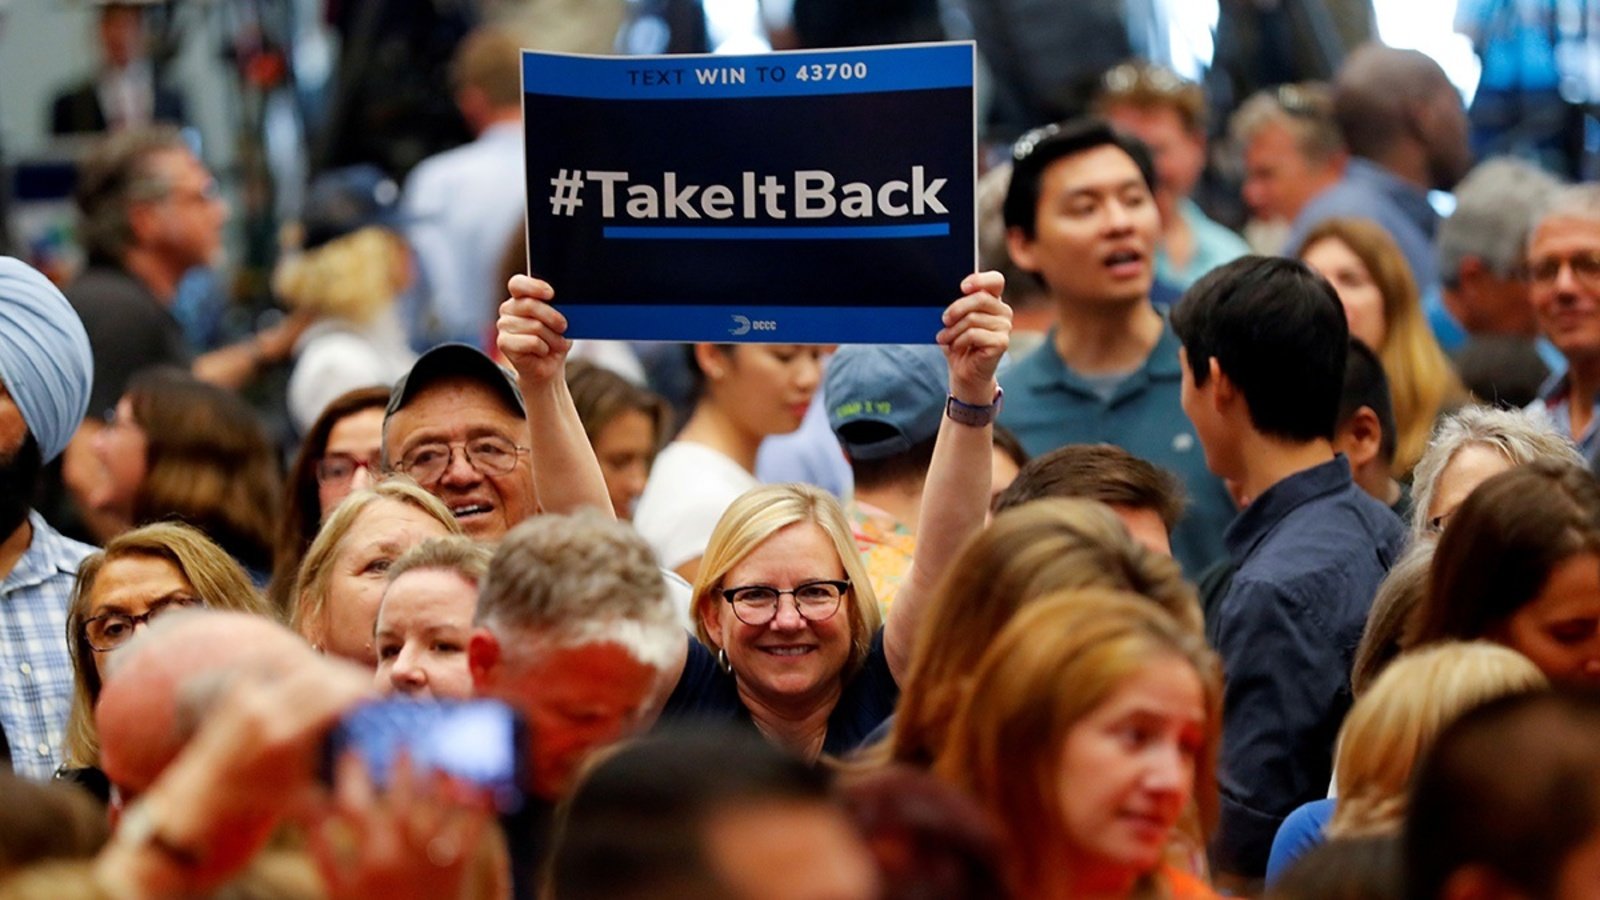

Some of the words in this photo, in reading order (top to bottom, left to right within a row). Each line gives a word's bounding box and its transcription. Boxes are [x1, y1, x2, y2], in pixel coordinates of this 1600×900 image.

[627, 69, 683, 86] TEXT
[695, 68, 746, 85] WIN
[756, 66, 786, 83] TO
[795, 63, 867, 81] 43700
[549, 165, 949, 218] #TakeItBack
